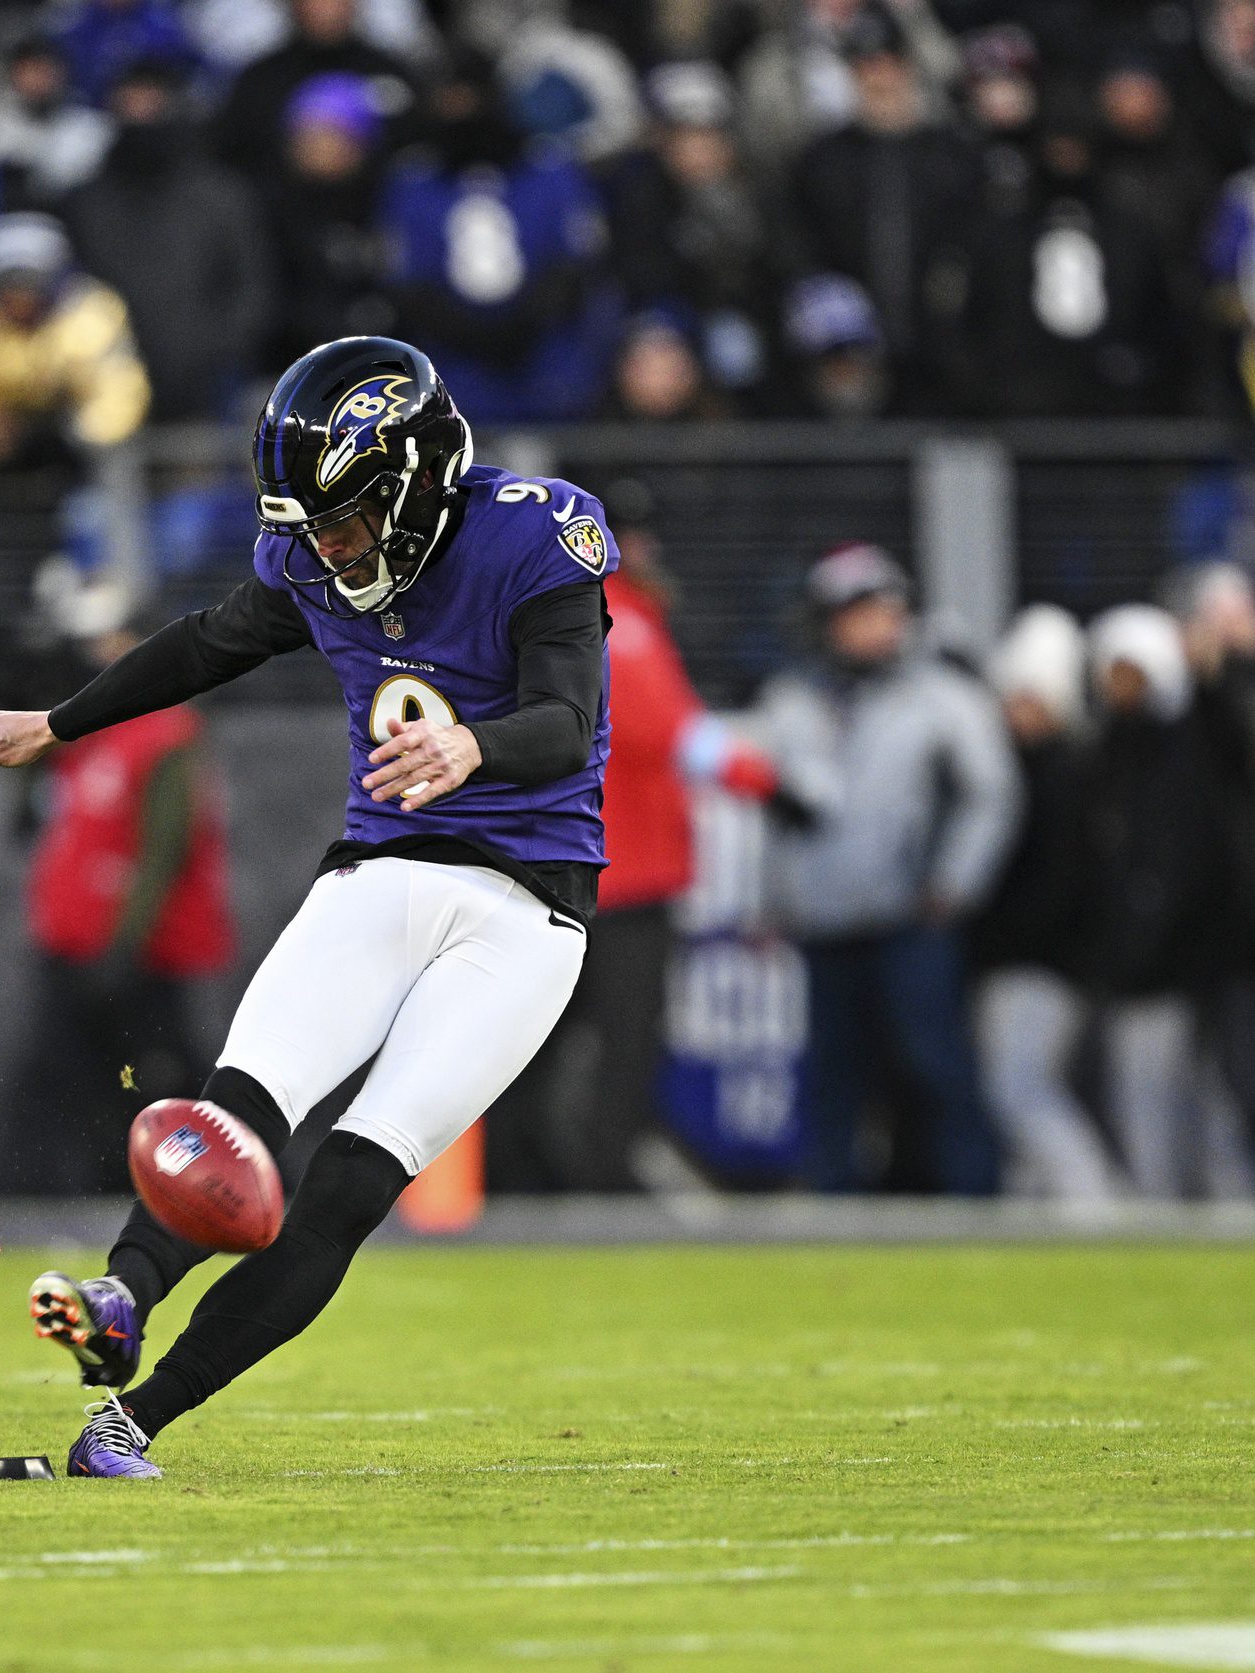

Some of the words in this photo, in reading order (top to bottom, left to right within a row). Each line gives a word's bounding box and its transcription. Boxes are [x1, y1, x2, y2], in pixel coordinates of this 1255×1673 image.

[562, 520, 594, 537] RAVENS
[386, 624, 402, 636] NFL
[379, 657, 435, 672] RAVENS
